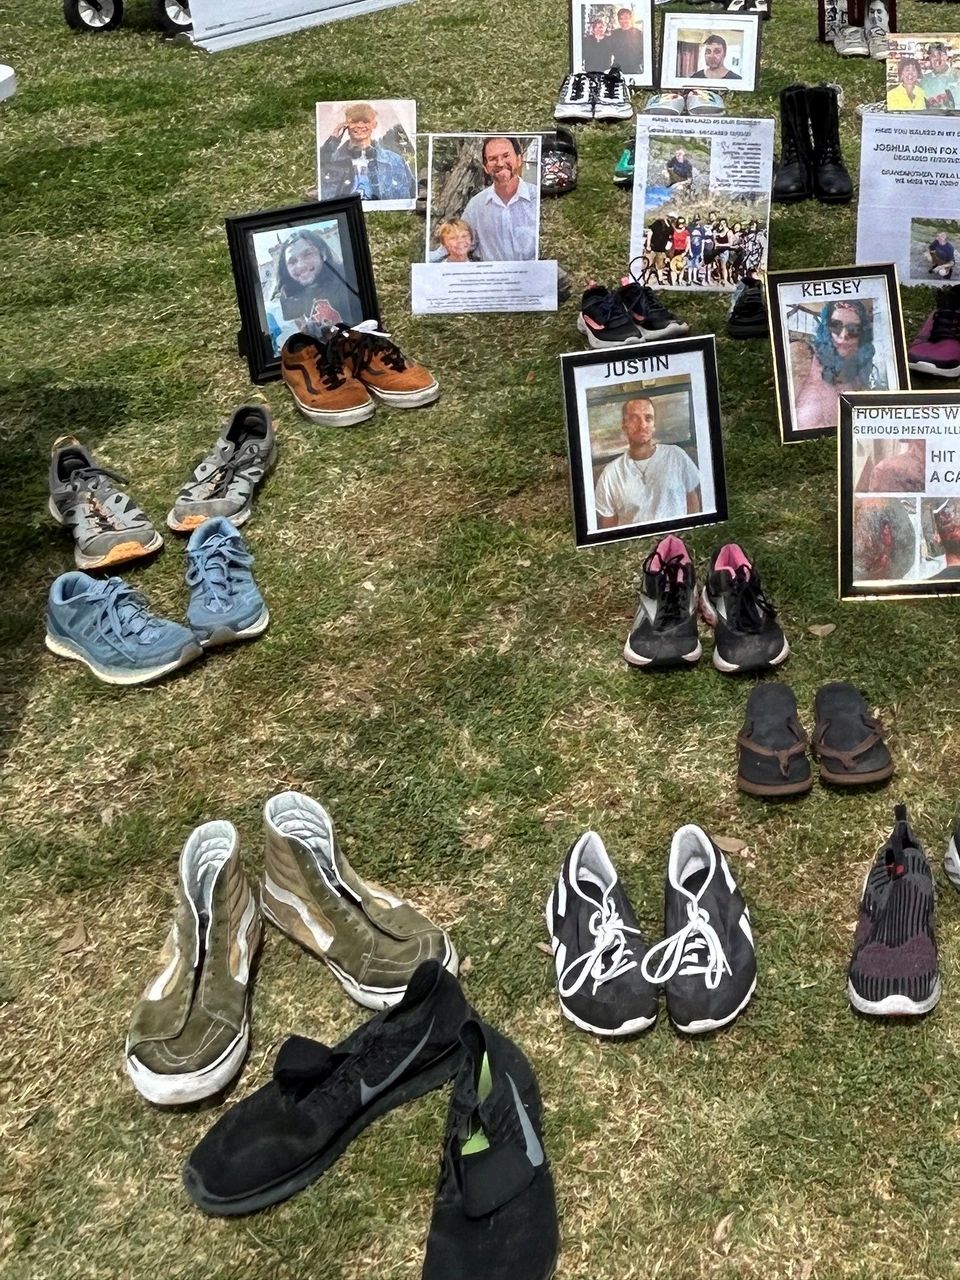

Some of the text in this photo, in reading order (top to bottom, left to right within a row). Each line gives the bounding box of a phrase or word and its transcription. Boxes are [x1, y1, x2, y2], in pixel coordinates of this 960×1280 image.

[873, 144, 910, 153] JOSHUA
[912, 146, 937, 154] JOHN
[940, 147, 958, 155] FOX
[801, 279, 862, 298] KELSEY
[604, 355, 670, 379] JUSTIN
[856, 407, 940, 420] HOMELESS
[853, 425, 899, 435] SERIOUS
[902, 425, 942, 435] MENTAL
[931, 450, 955, 463] HIT
[929, 471, 940, 483] A
